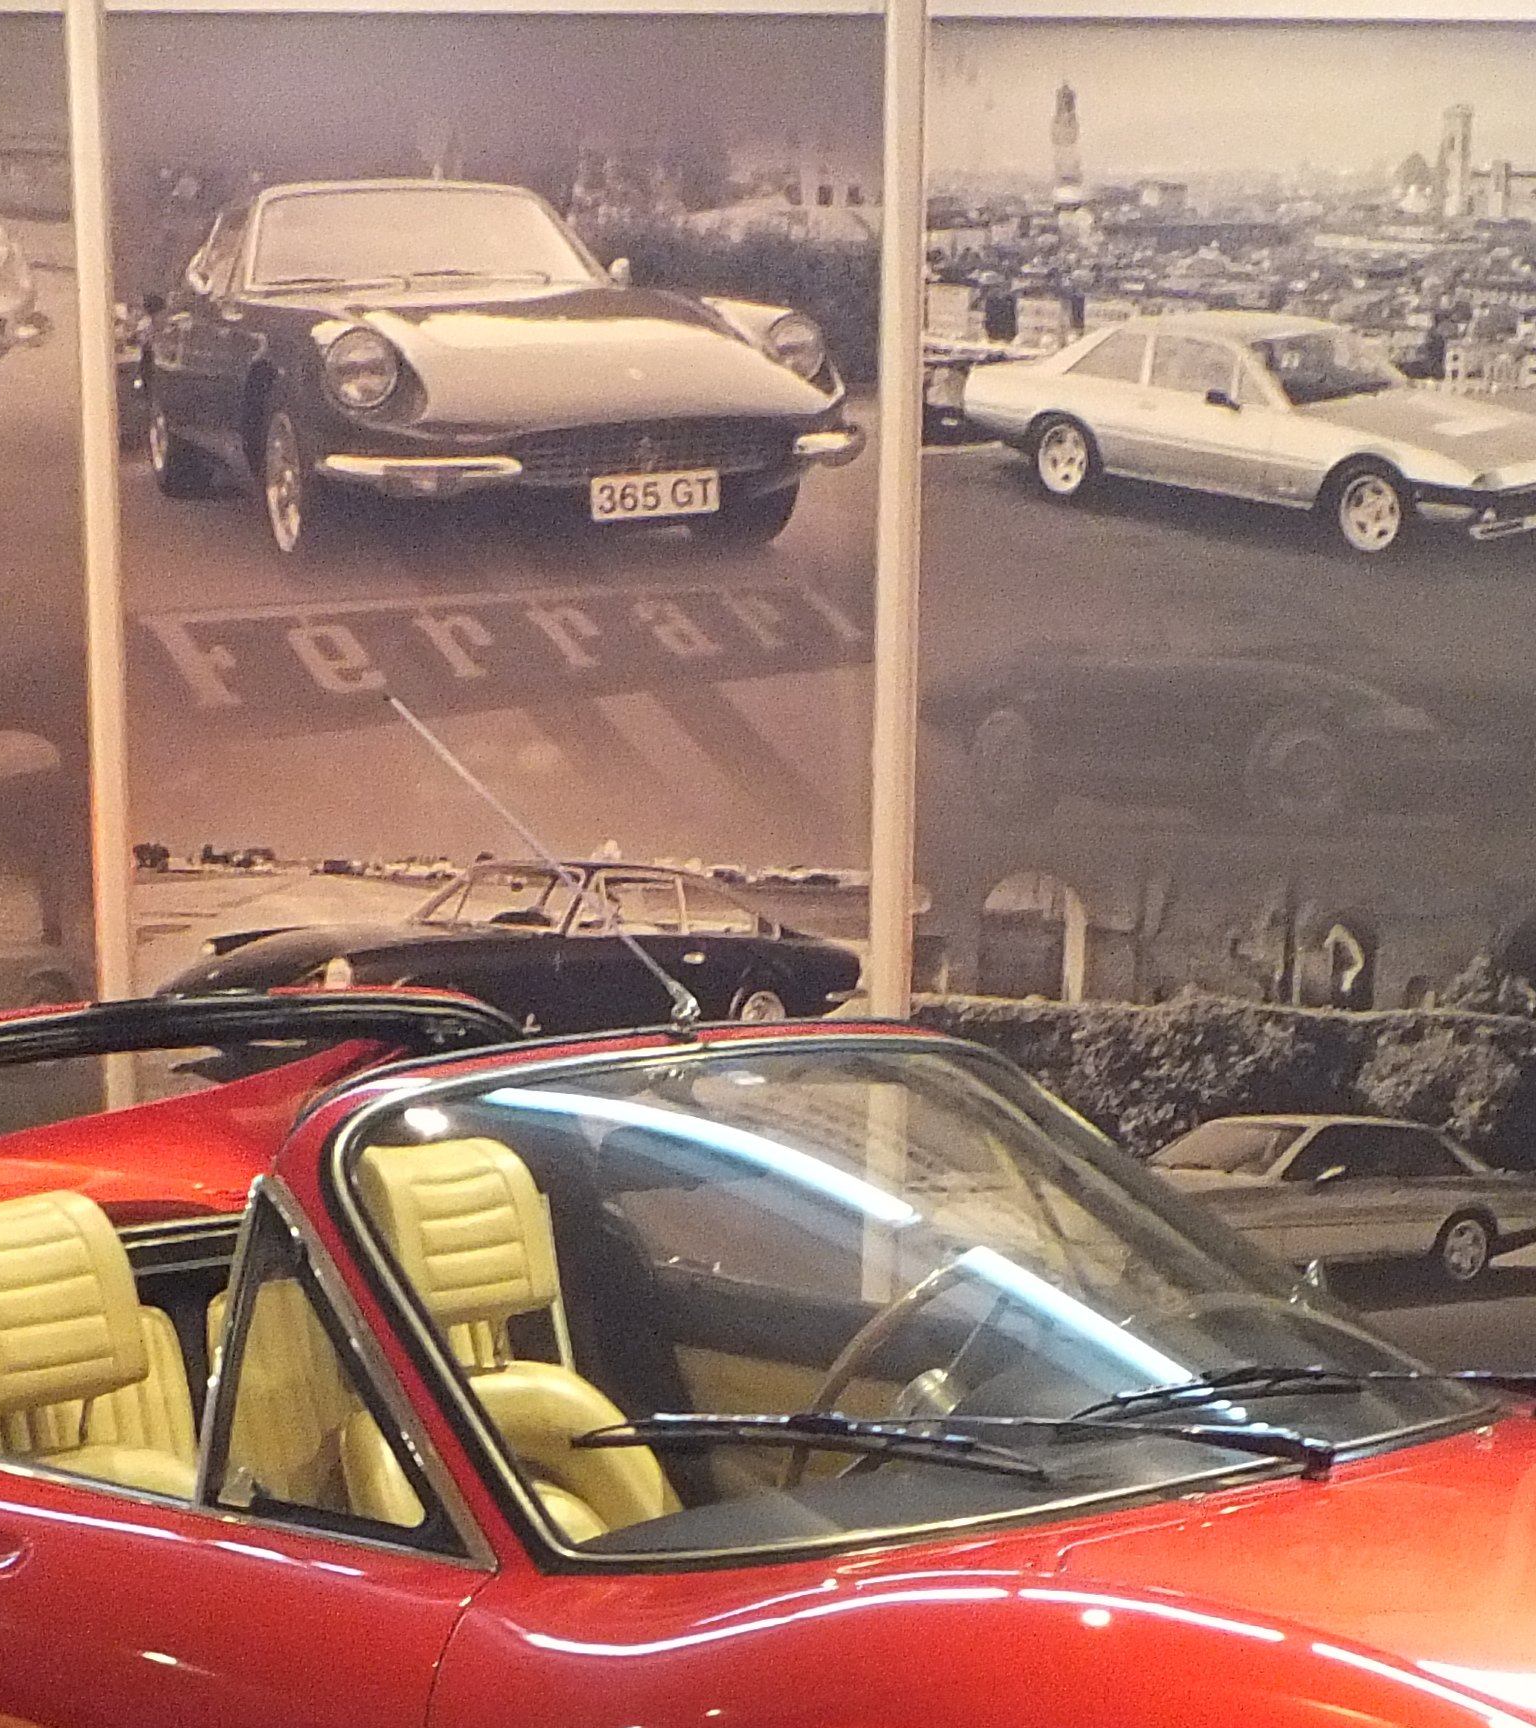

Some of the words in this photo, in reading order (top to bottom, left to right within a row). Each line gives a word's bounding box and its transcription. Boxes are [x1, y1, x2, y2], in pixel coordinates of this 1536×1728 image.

[598, 481, 662, 514] 365
[670, 477, 713, 507] GT
[138, 584, 864, 704] Ferrari
